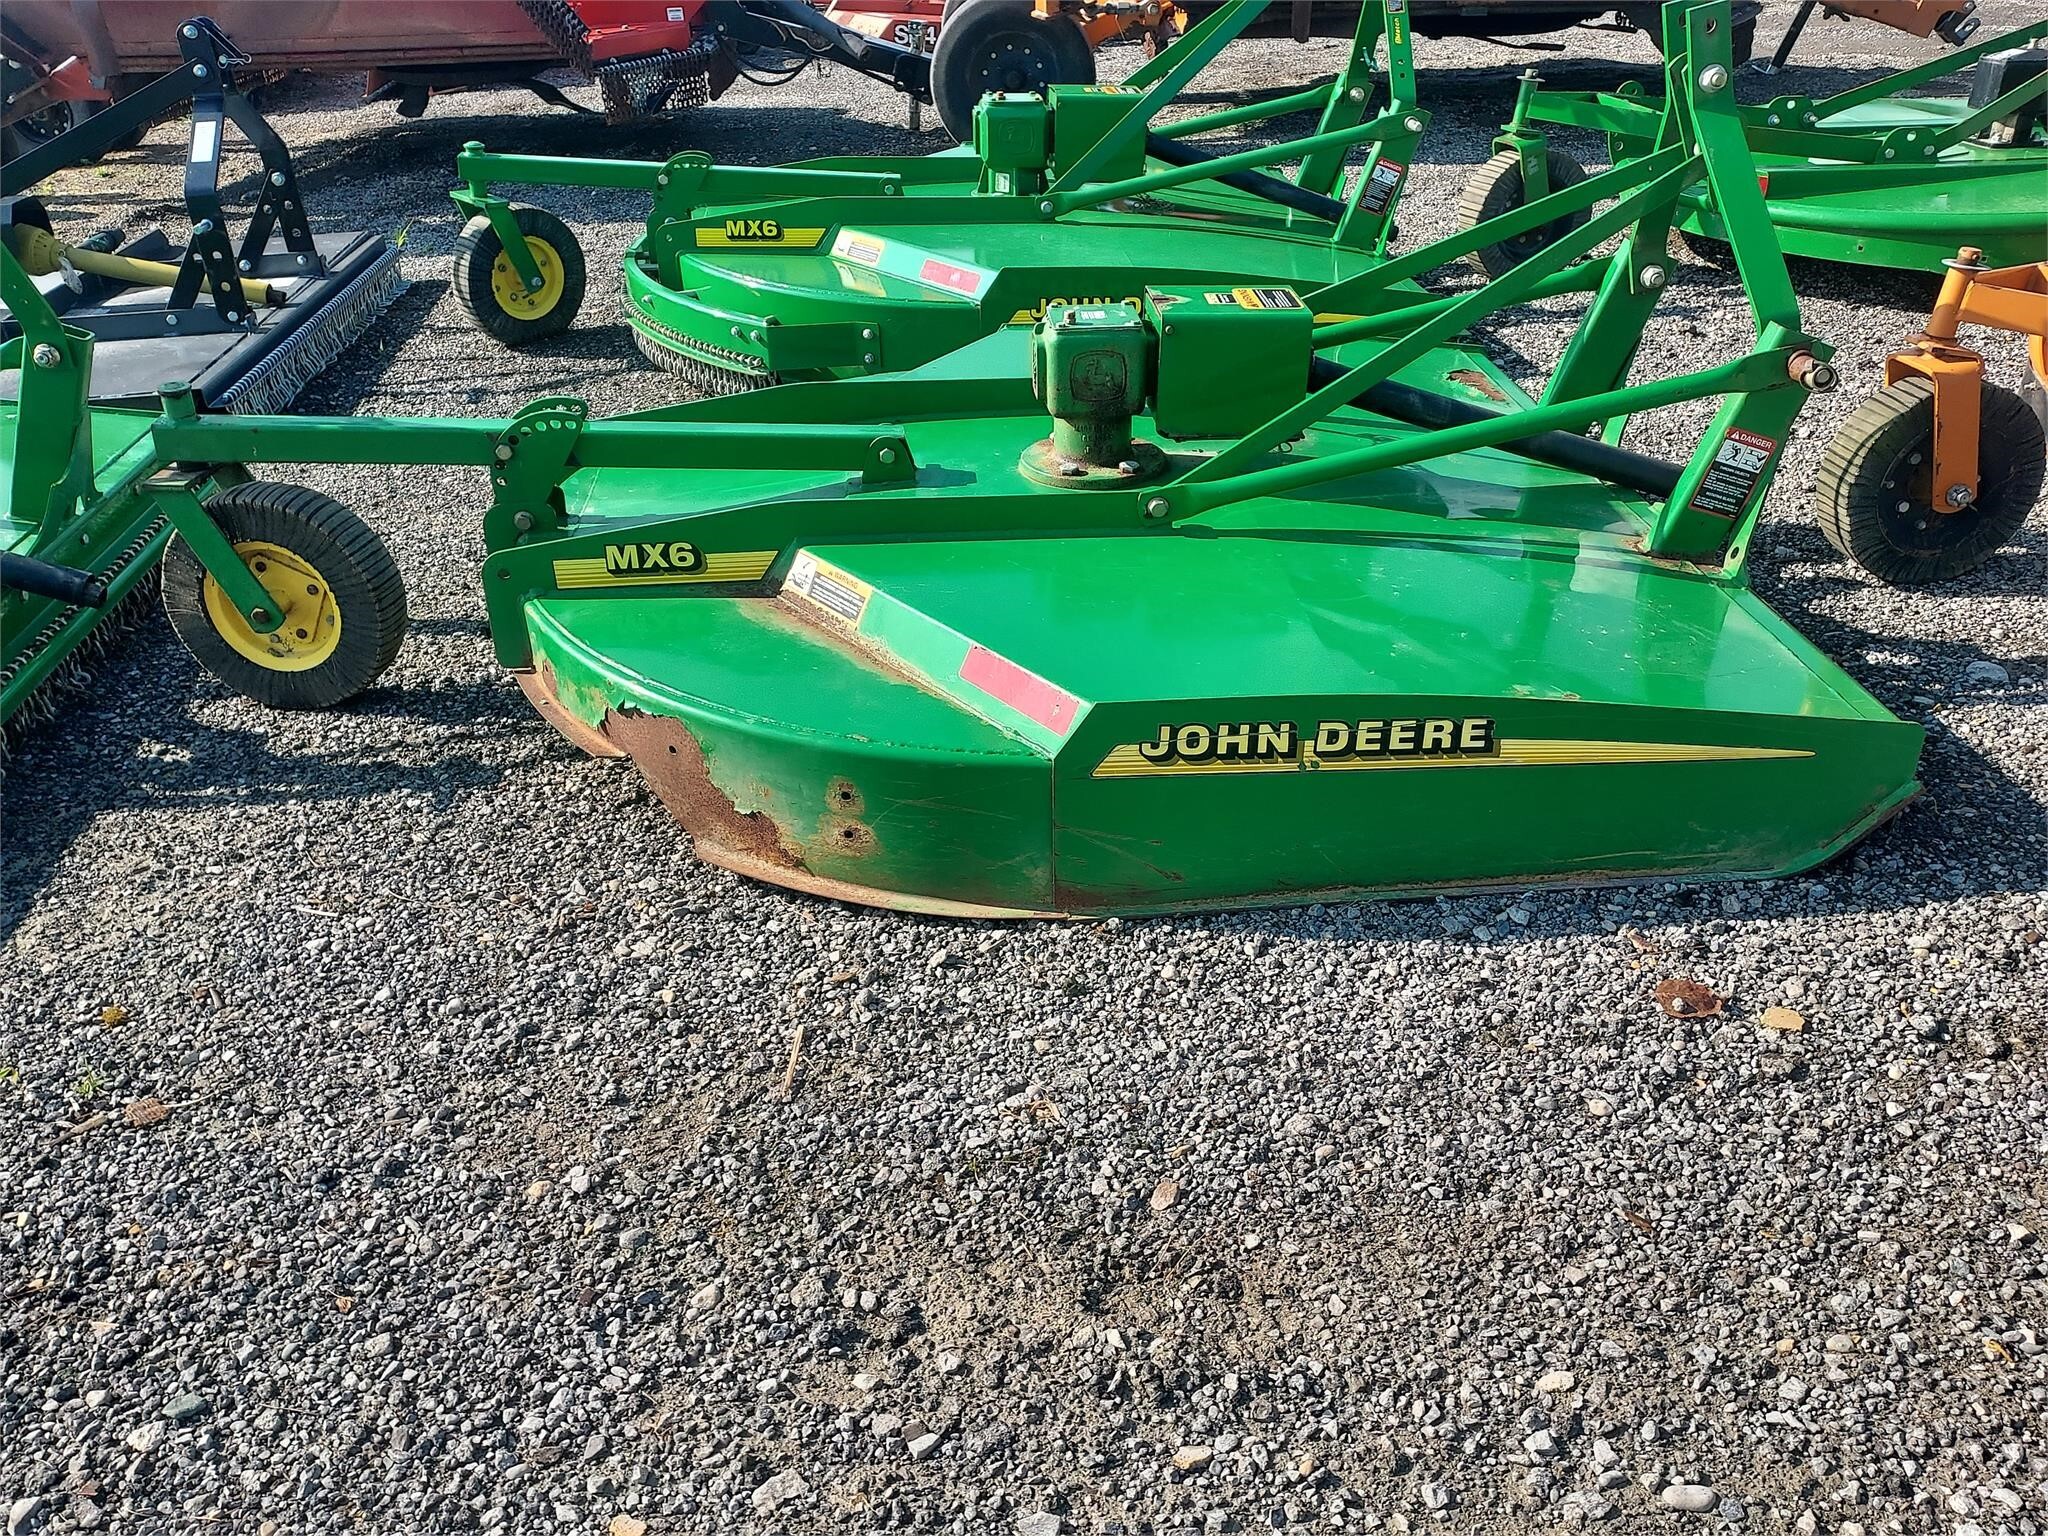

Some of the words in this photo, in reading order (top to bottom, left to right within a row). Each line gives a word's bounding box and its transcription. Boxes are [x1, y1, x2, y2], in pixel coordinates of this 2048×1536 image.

[725, 219, 778, 237] MX6
[1740, 433, 1773, 449] DANGER
[605, 542, 695, 570] MX6
[1139, 722, 1291, 757] JOHN
[1316, 718, 1488, 752] DEERE
